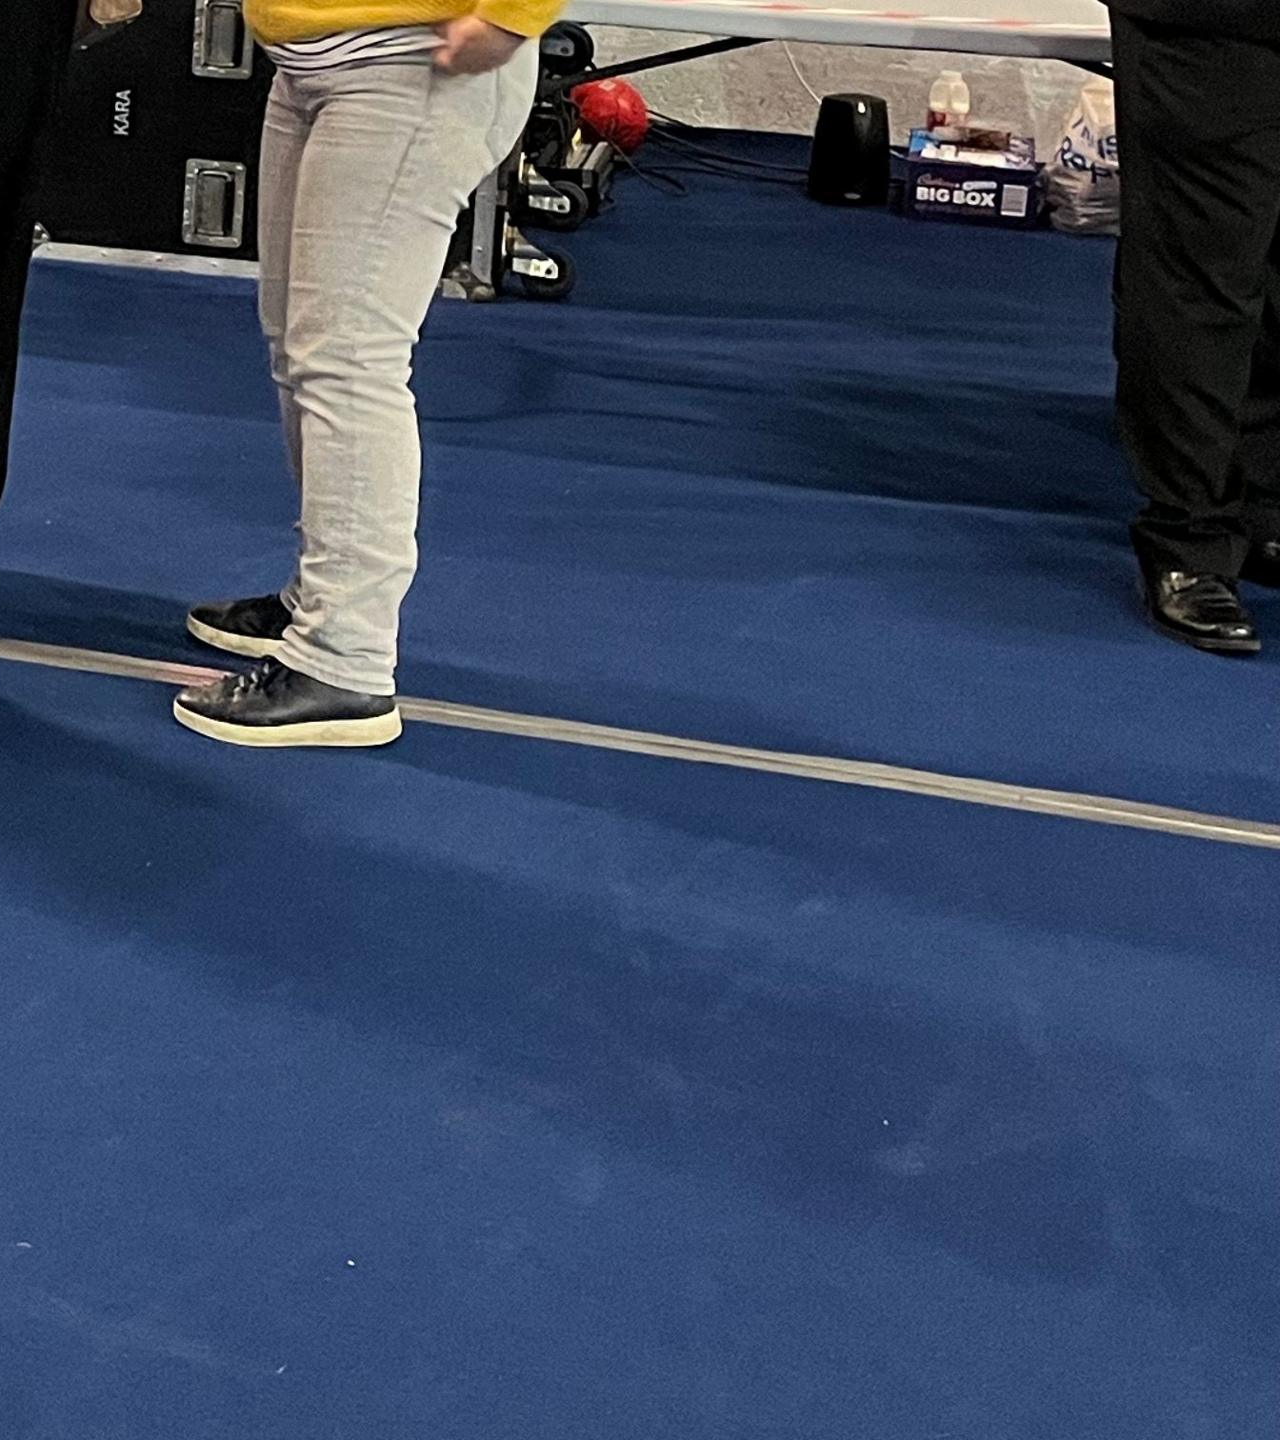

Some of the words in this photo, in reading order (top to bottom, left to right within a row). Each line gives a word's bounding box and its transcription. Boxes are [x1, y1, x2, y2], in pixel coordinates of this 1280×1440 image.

[113, 89, 131, 136] KARA
[916, 186, 950, 203] BIG
[952, 189, 996, 208] BOX
